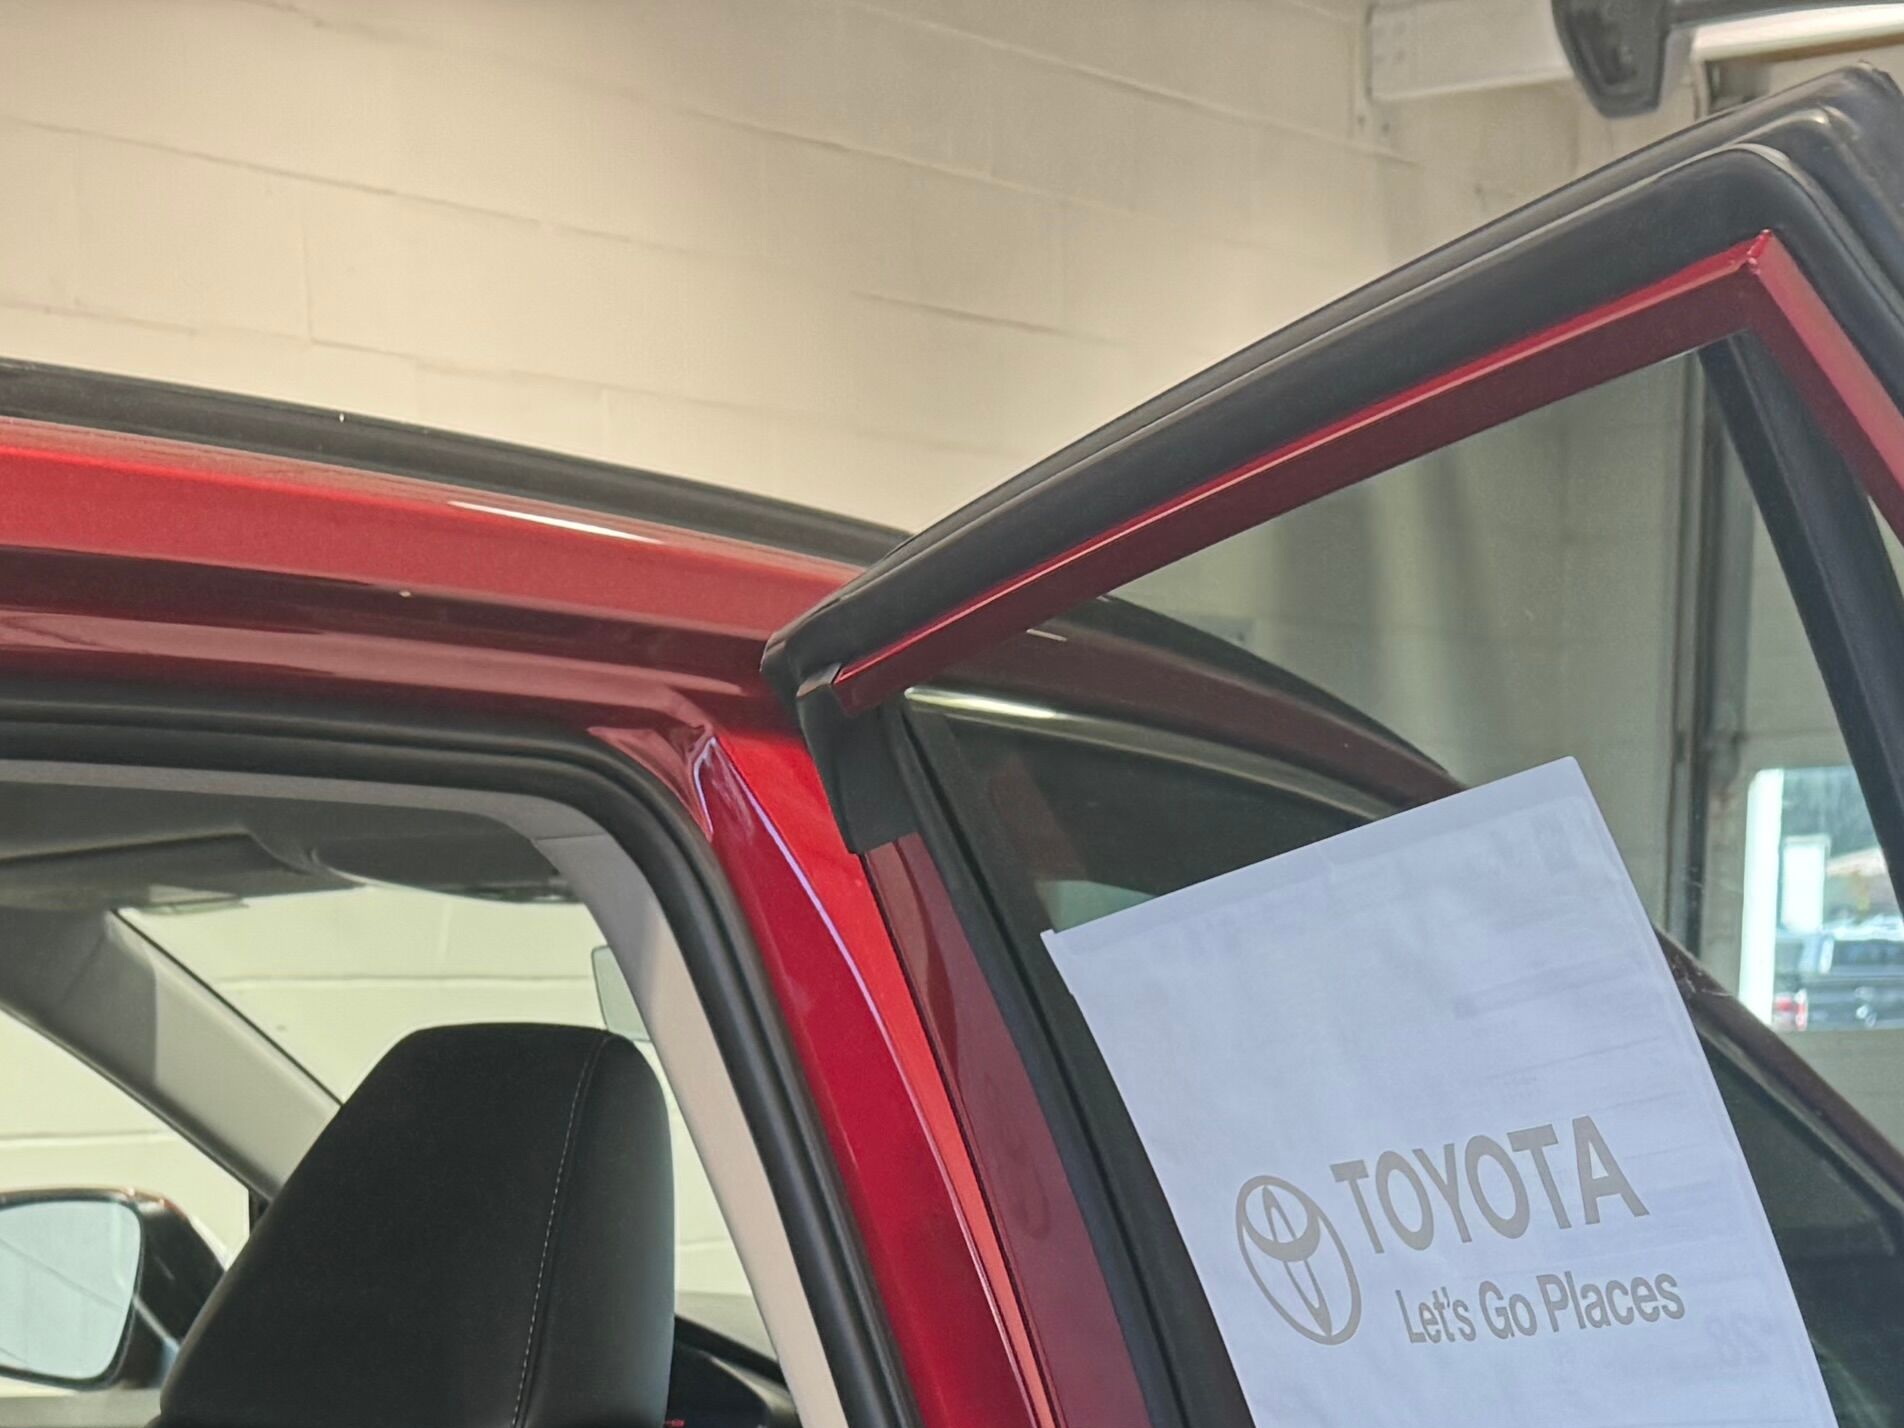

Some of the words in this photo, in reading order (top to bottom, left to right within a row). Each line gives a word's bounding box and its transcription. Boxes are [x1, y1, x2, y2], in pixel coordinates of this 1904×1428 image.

[1330, 1116, 1649, 1253] TOYOTA
[1395, 1286, 1476, 1343] Let's
[1478, 1281, 1537, 1339] Go
[1536, 1271, 1685, 1332] Places
